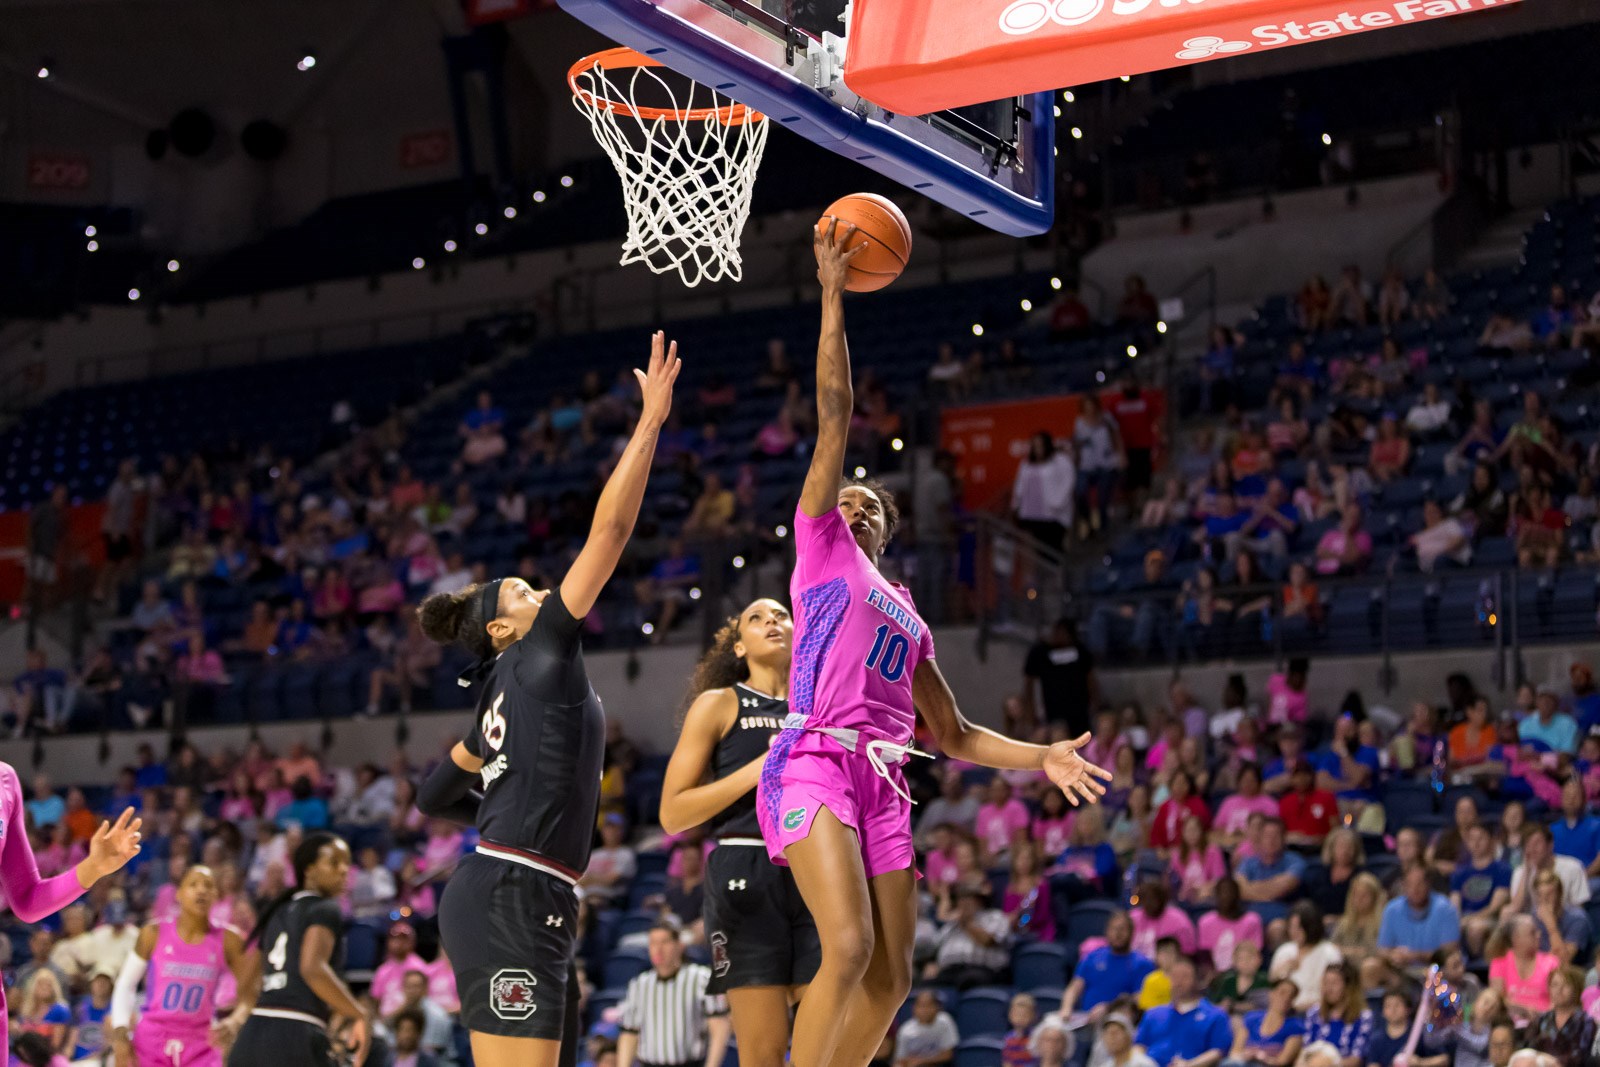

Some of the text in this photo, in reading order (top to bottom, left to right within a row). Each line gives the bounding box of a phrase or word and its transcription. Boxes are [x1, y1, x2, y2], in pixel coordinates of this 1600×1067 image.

[1251, 0, 1516, 46] State Far
[864, 586, 921, 645] FLORID
[864, 623, 909, 683] 10
[740, 716, 777, 730] SOUTH
[267, 932, 289, 971] 4
[161, 982, 205, 1013] 00
